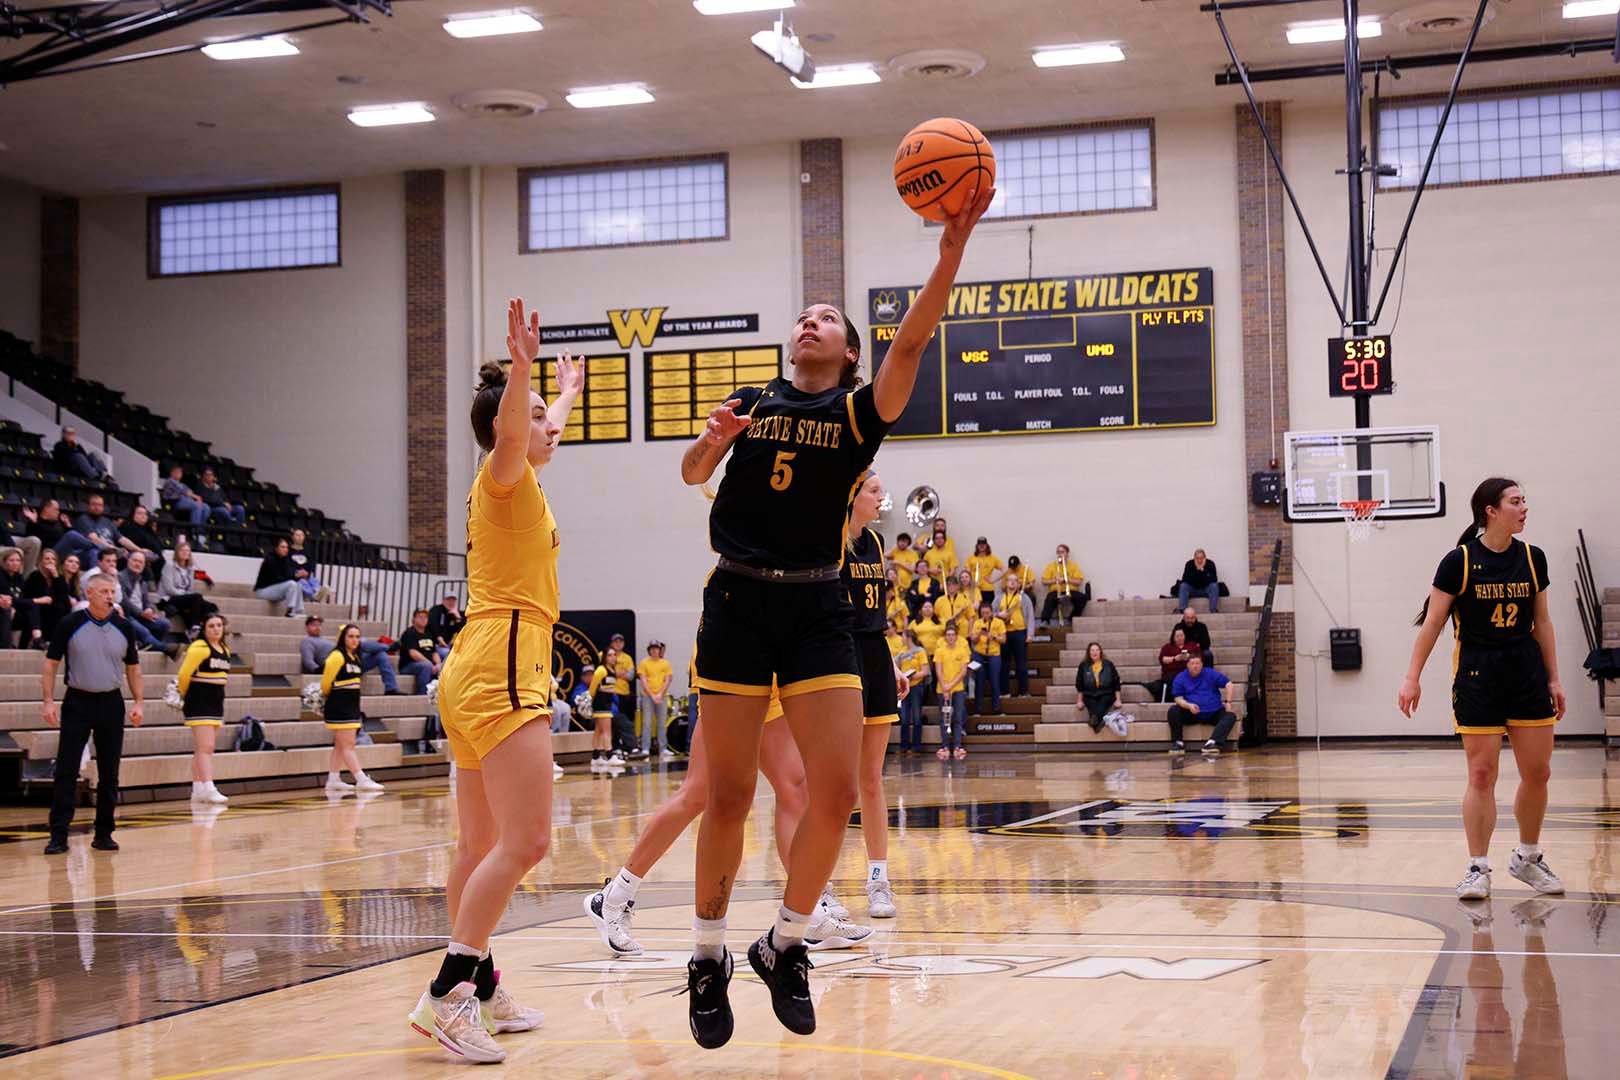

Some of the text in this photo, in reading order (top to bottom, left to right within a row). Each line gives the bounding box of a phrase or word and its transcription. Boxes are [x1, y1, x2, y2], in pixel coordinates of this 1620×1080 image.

[996, 280, 1068, 313] STATE
[1075, 271, 1200, 308] WILDCATS
[1142, 310, 1204, 326] PLY FL PTS
[607, 306, 669, 350] W
[663, 319, 748, 332] OF THE YEAR AWARDS
[542, 327, 609, 340] SCHOLAR ATHLETE
[1086, 344, 1114, 357] UMD
[1344, 339, 1385, 359] 5:30
[961, 350, 989, 363] WSC
[1024, 353, 1052, 363] PERIOD
[1342, 360, 1378, 390] 20
[985, 391, 1005, 400] T.O.L.
[1014, 387, 1063, 399] PLAYER FOUL
[1072, 387, 1092, 396] T.O.L.
[1100, 385, 1124, 395] FOULS
[954, 392, 978, 402] FOULS
[955, 422, 979, 432] SCORE
[1026, 421, 1051, 430] MATCH
[1100, 416, 1125, 426] SCORE
[796, 418, 842, 449] STATE
[770, 450, 797, 491] 5
[864, 583, 879, 609] 31
[1474, 581, 1530, 599] WAYNE STATE
[1490, 602, 1519, 628] 42
